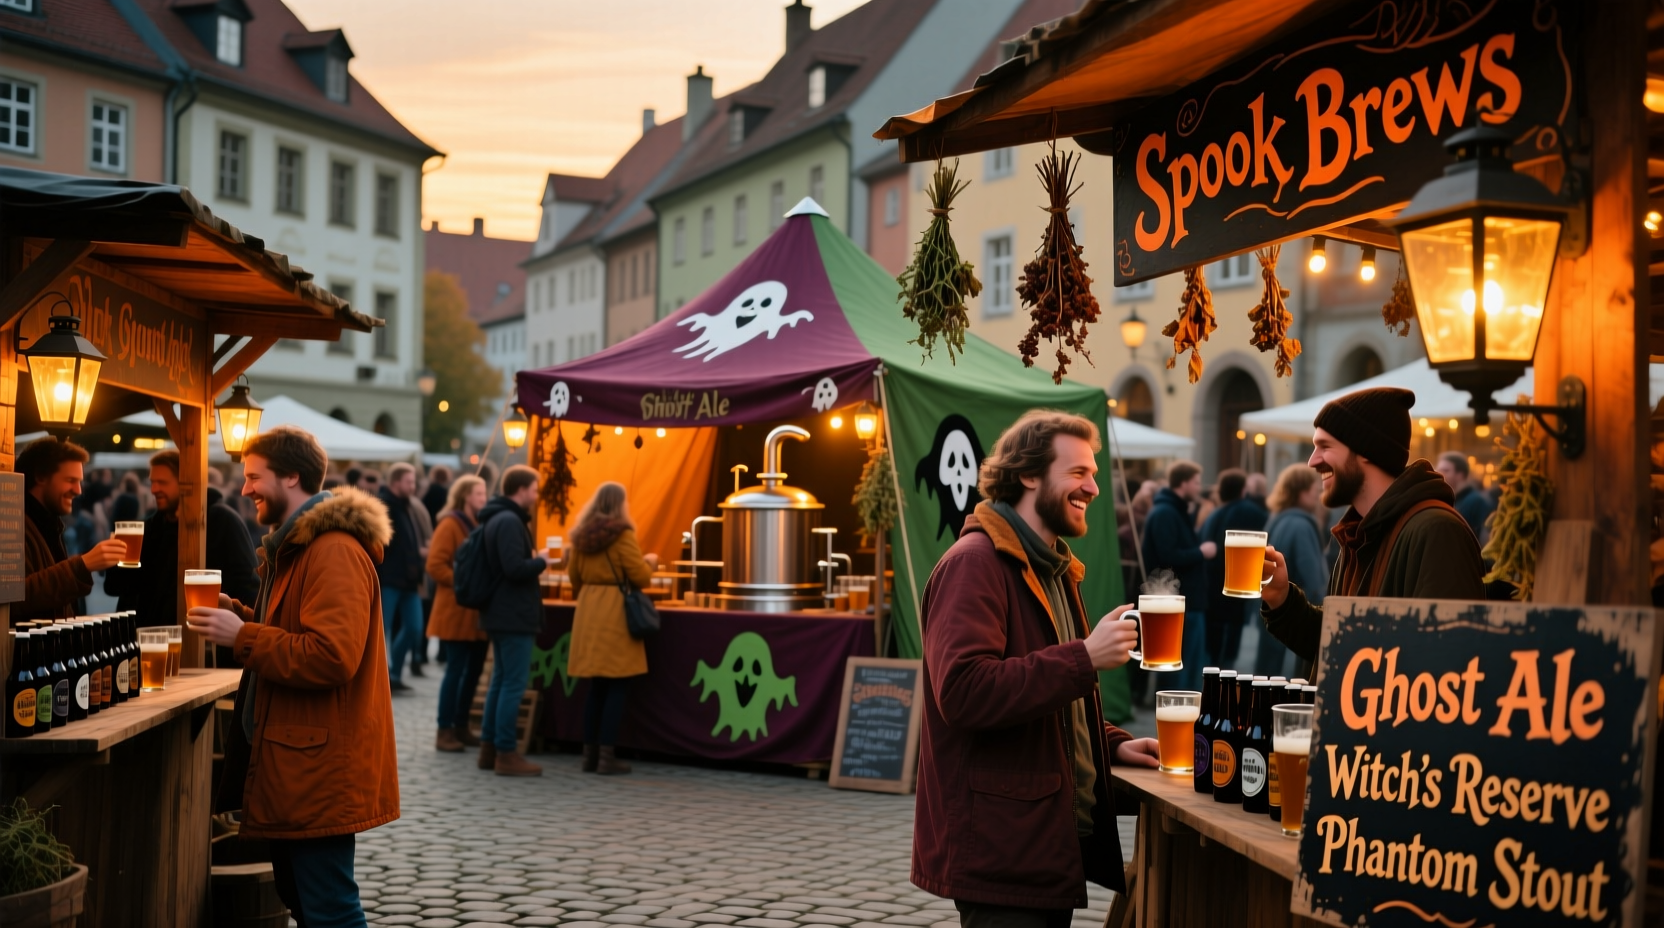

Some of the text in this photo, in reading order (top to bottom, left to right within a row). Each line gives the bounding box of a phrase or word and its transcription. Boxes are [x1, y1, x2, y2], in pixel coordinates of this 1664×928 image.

[1134, 33, 1522, 252] Spook Brews
[694, 389, 730, 419] Ale
[1340, 647, 1605, 745] Ghost Ale
[1324, 744, 1610, 833] Witch's Reserve
[1316, 814, 1610, 922] Phantom Stout
